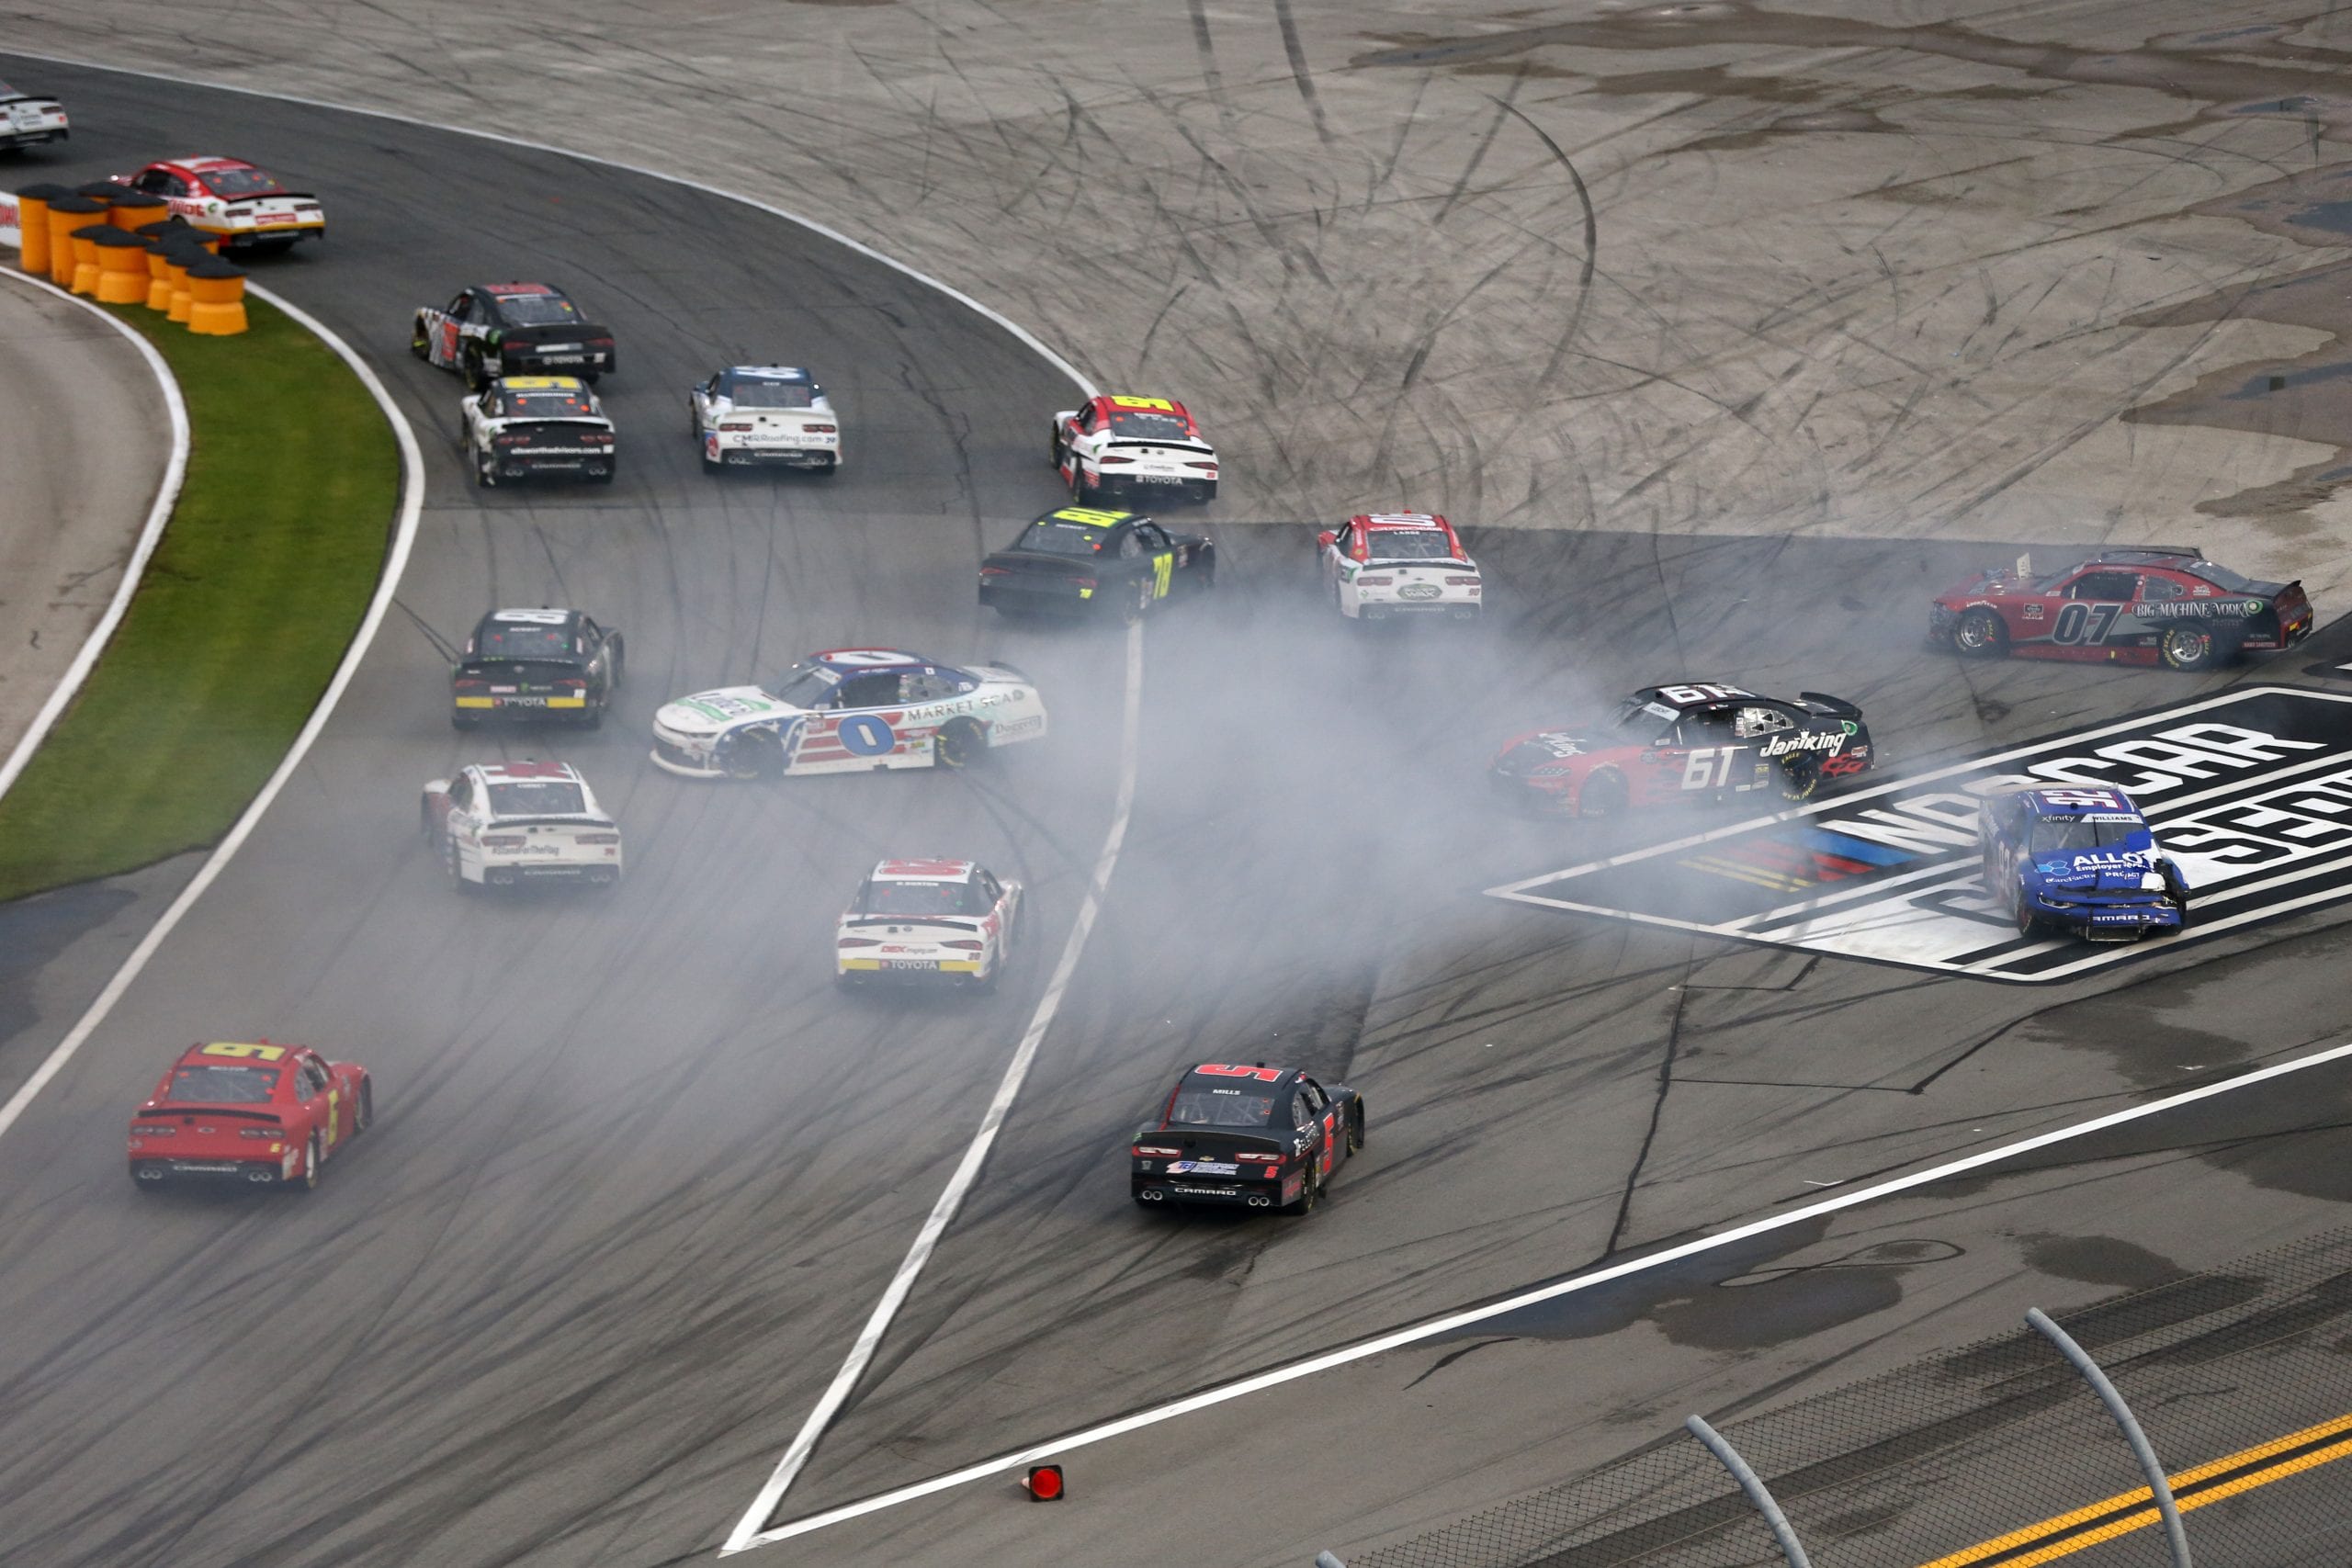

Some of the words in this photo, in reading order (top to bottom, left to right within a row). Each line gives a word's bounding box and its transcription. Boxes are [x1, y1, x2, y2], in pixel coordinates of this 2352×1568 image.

[1145, 475, 1182, 485] TOYOTA
[2132, 603, 2155, 618] BIG
[2158, 602, 2212, 618] MACHINE
[2213, 602, 2252, 617] VODKA
[2052, 603, 2125, 646] 07
[908, 700, 974, 721] MARKET
[838, 715, 895, 756] 0
[1681, 749, 1735, 790] 61
[2042, 815, 2075, 823] xfinity
[890, 960, 937, 970] TOYOTA
[1264, 1166, 1280, 1179] 5
[1174, 1188, 1237, 1196] CAMARO
